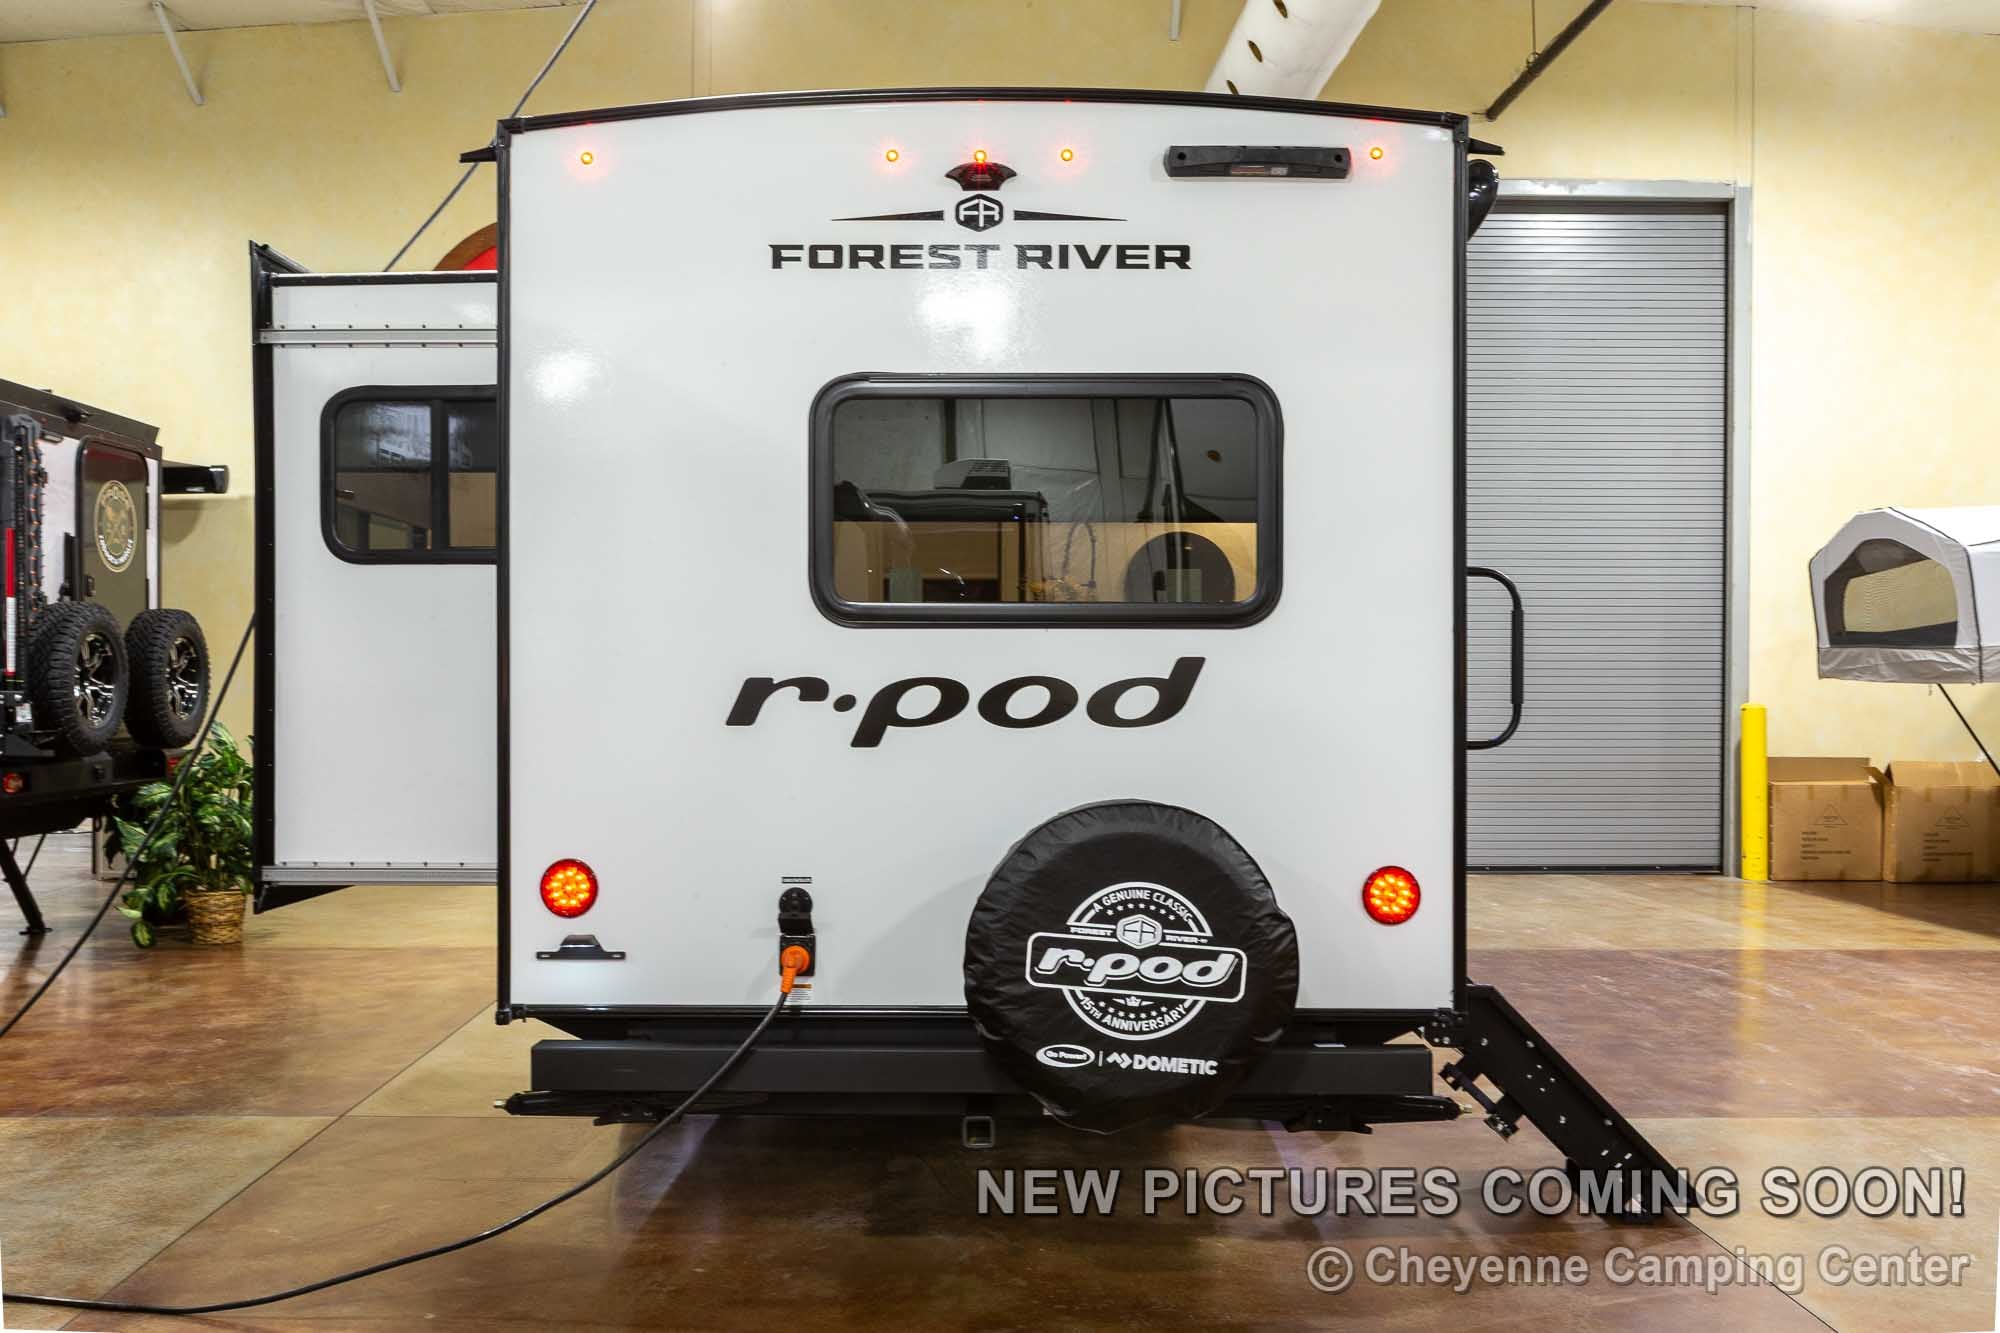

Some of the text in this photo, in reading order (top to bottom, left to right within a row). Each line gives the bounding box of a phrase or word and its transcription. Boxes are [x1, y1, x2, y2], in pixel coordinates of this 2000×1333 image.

[768, 244, 1192, 270] FOREST RIVER
[1093, 889, 1194, 922] A GENUINE CLASSIC
[1069, 926, 1114, 937] FOREST
[1102, 1004, 1187, 1032] ANNIVERSARY
[1133, 1054, 1219, 1076] DOMETIC
